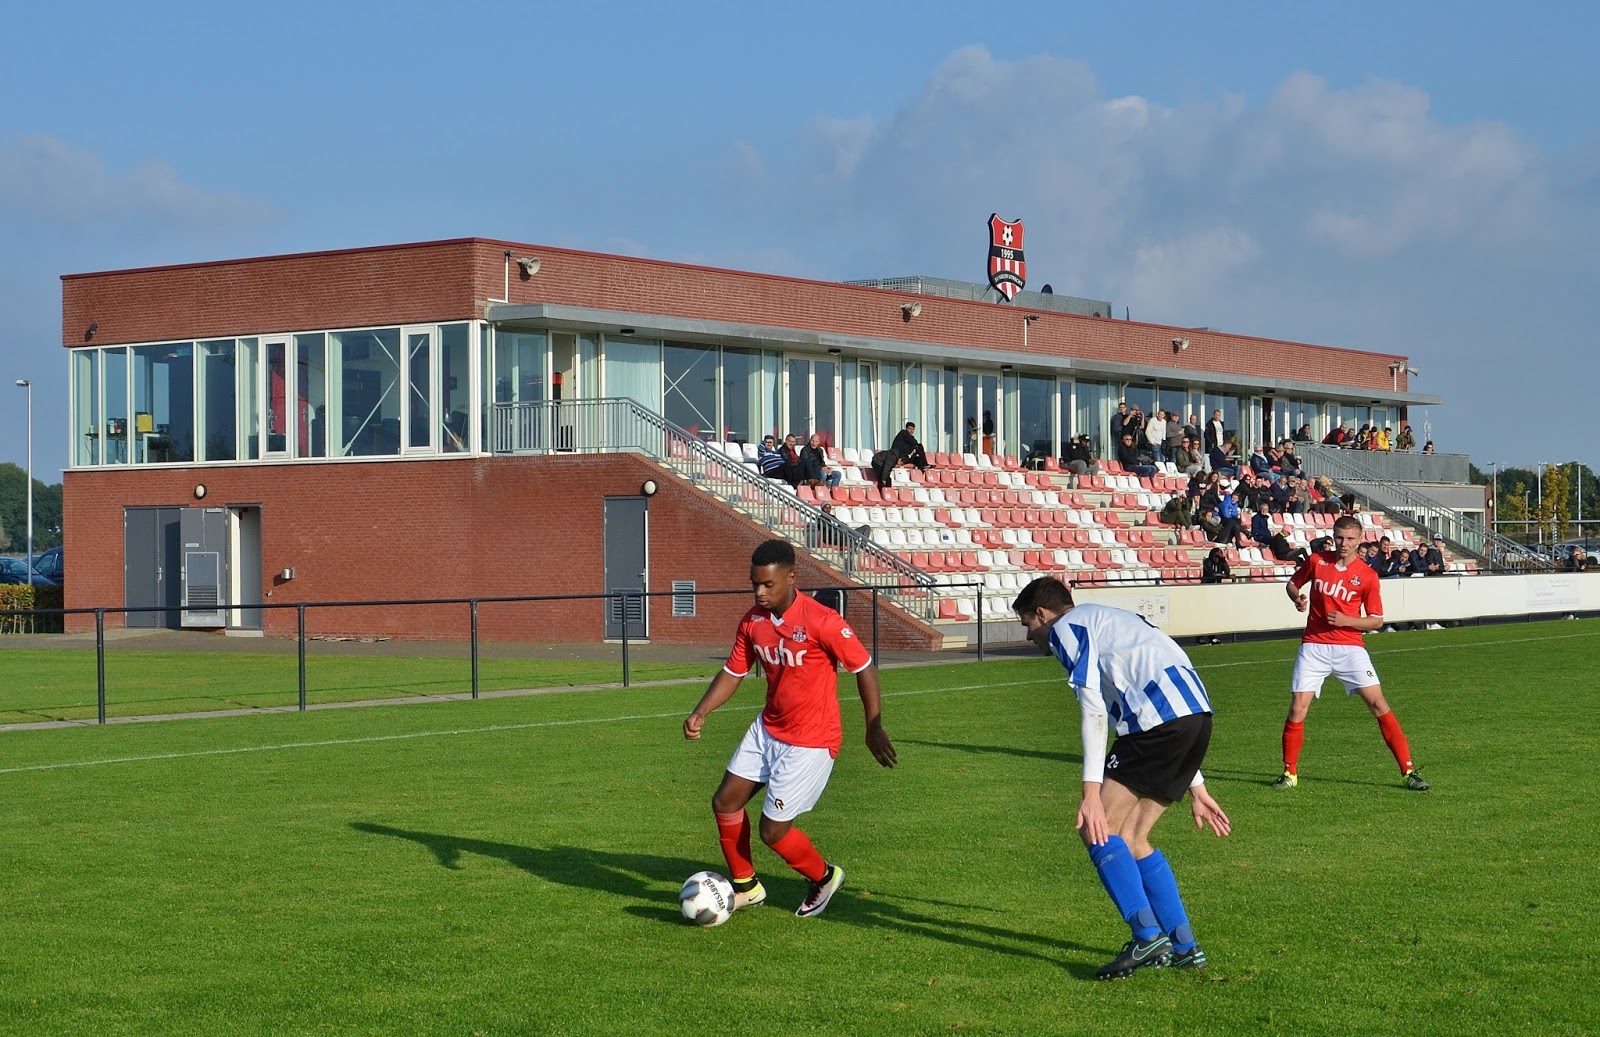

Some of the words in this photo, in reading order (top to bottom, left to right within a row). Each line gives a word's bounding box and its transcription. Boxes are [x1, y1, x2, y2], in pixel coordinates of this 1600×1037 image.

[1001, 249, 1014, 260] 1995
[1314, 579, 1357, 602] nuhr
[753, 638, 807, 667] nuhr
[705, 878, 726, 911] DERBYSTAR
